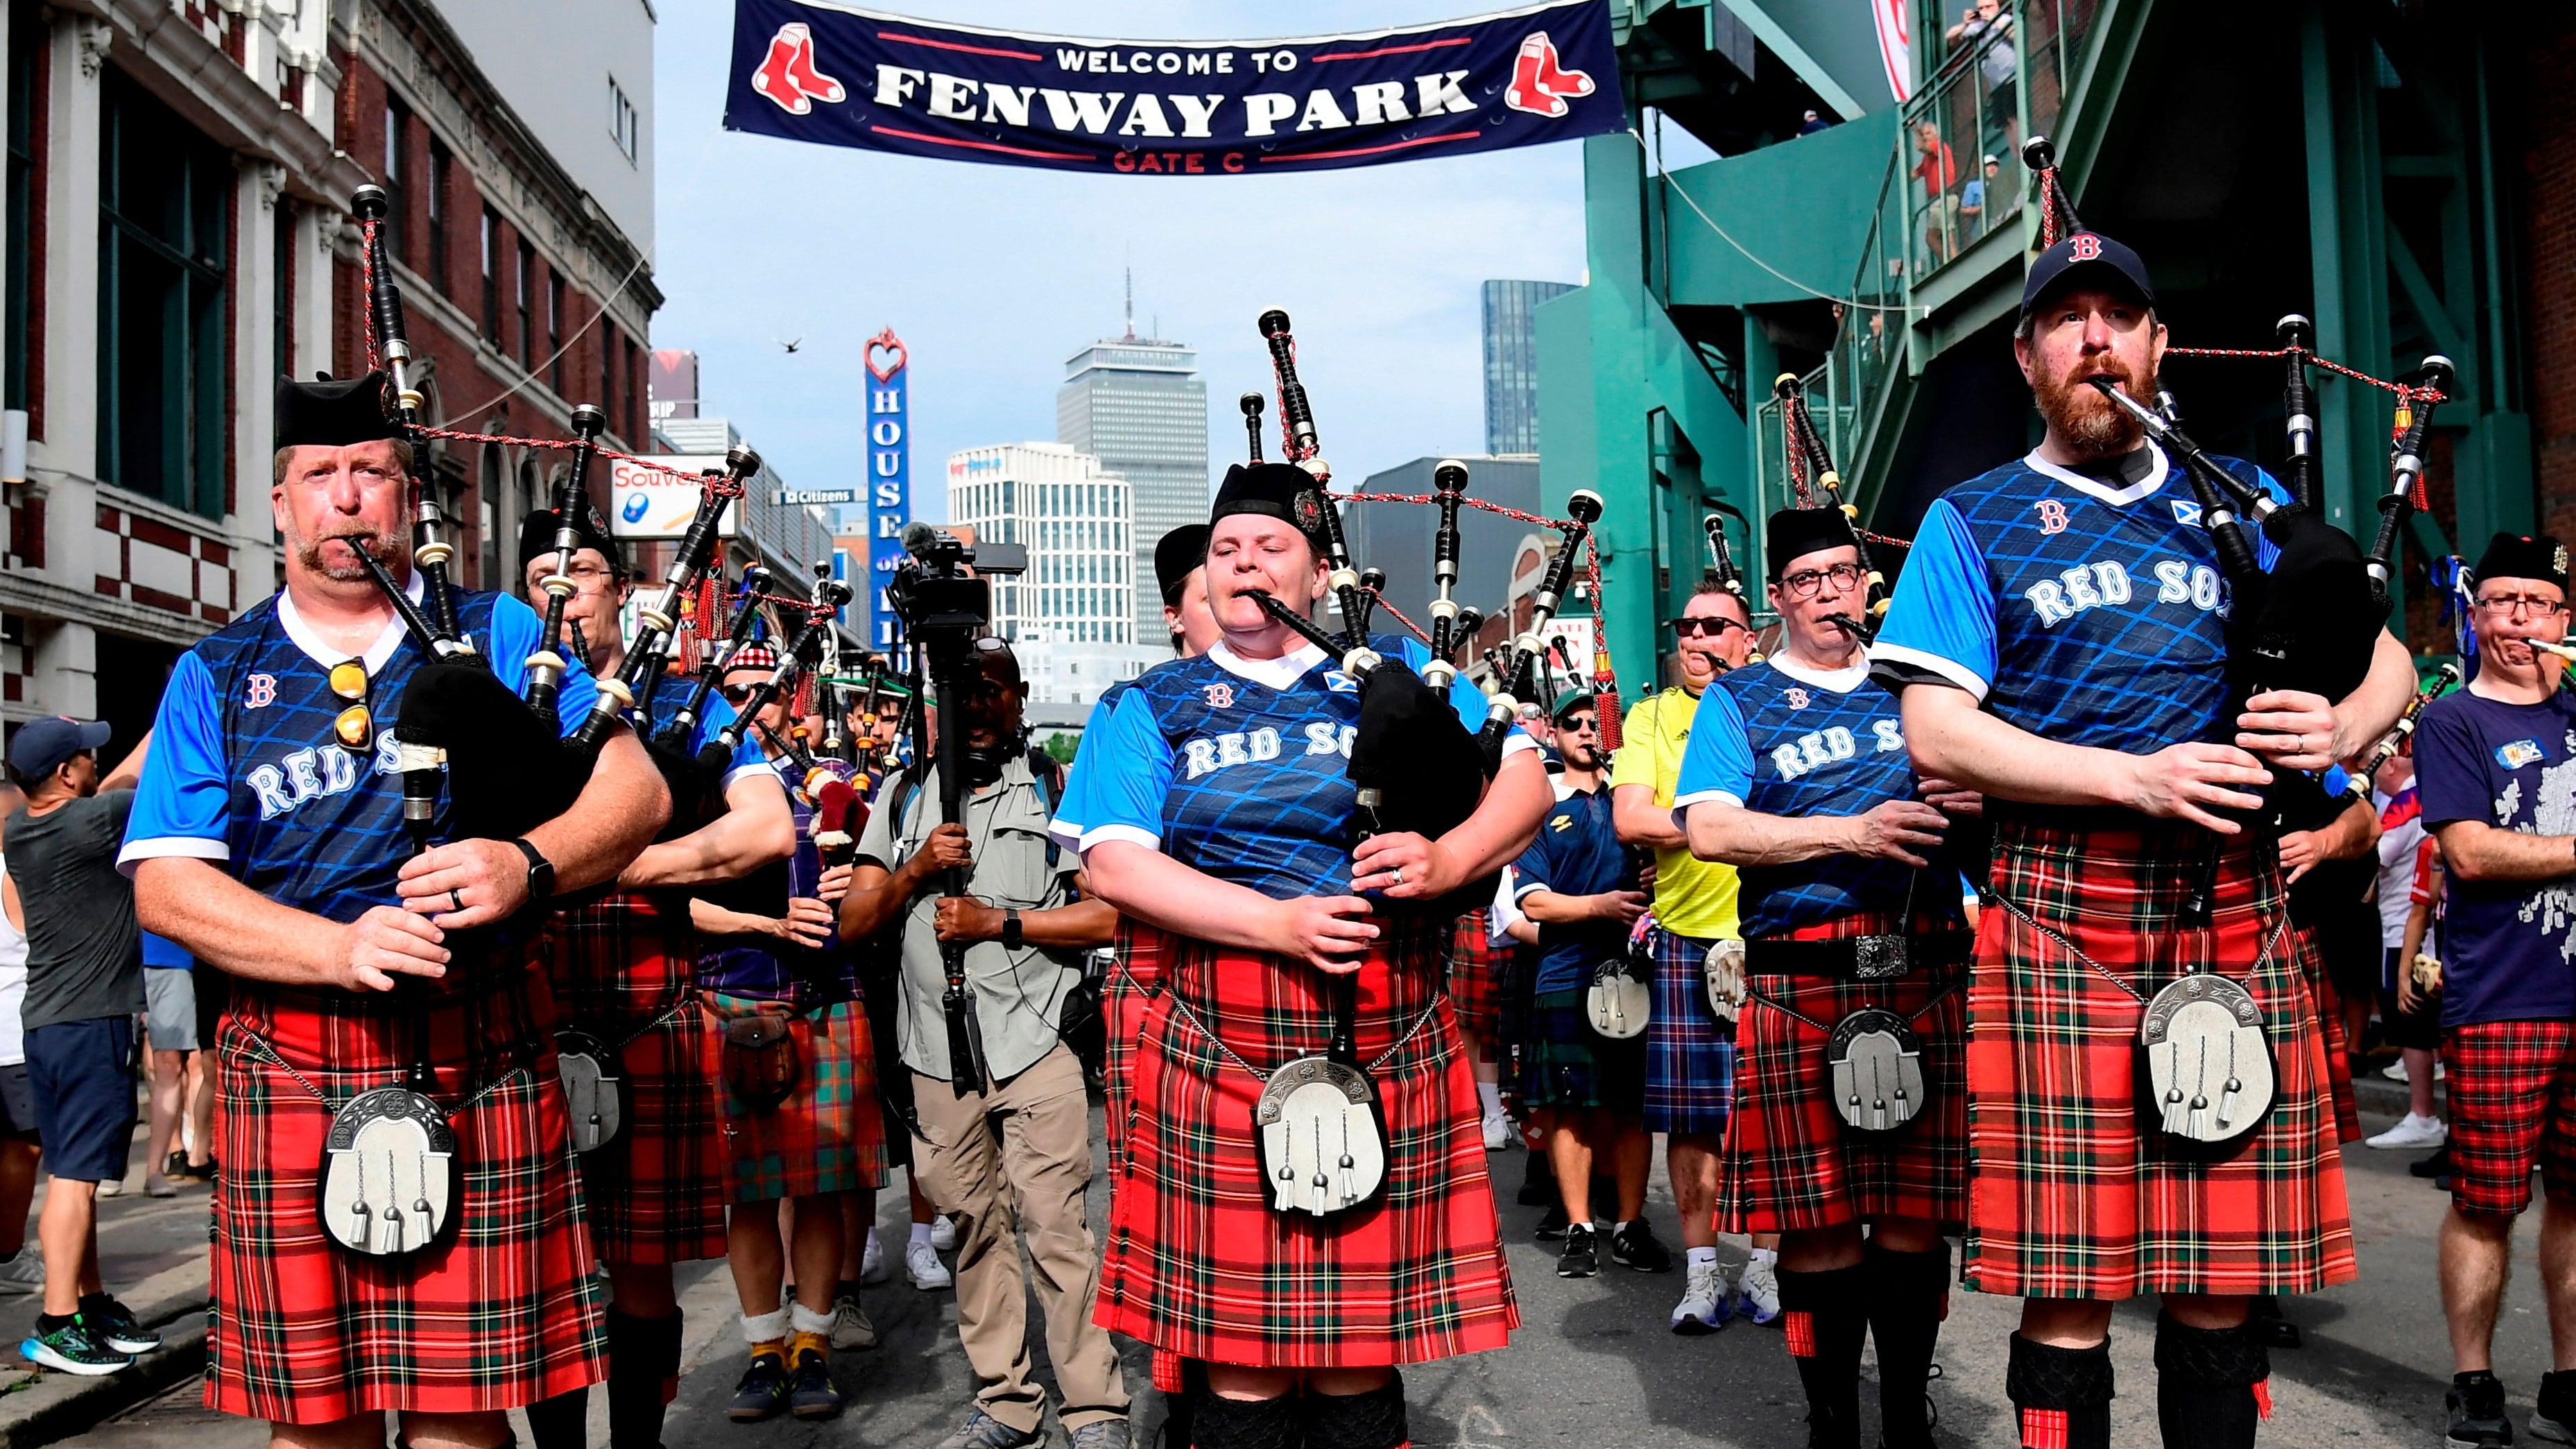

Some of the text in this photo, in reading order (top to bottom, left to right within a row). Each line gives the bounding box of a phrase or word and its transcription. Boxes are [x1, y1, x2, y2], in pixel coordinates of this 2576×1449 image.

[1056, 48, 1298, 75] WELCOME TO
[872, 63, 1479, 138] FENWAY PARK
[1114, 151, 1244, 173] GATE C
[2068, 233, 2102, 263] B
[873, 388, 902, 539] HOUSE
[798, 490, 850, 504] Citizens
[2034, 499, 2069, 535] B
[2024, 560, 2132, 628] RED
[245, 674, 277, 709] B
[1203, 683, 1235, 708] B
[1783, 687, 1810, 710] B
[1184, 726, 1282, 780] RED
[1770, 726, 1856, 783] RED
[246, 743, 357, 821] RED
